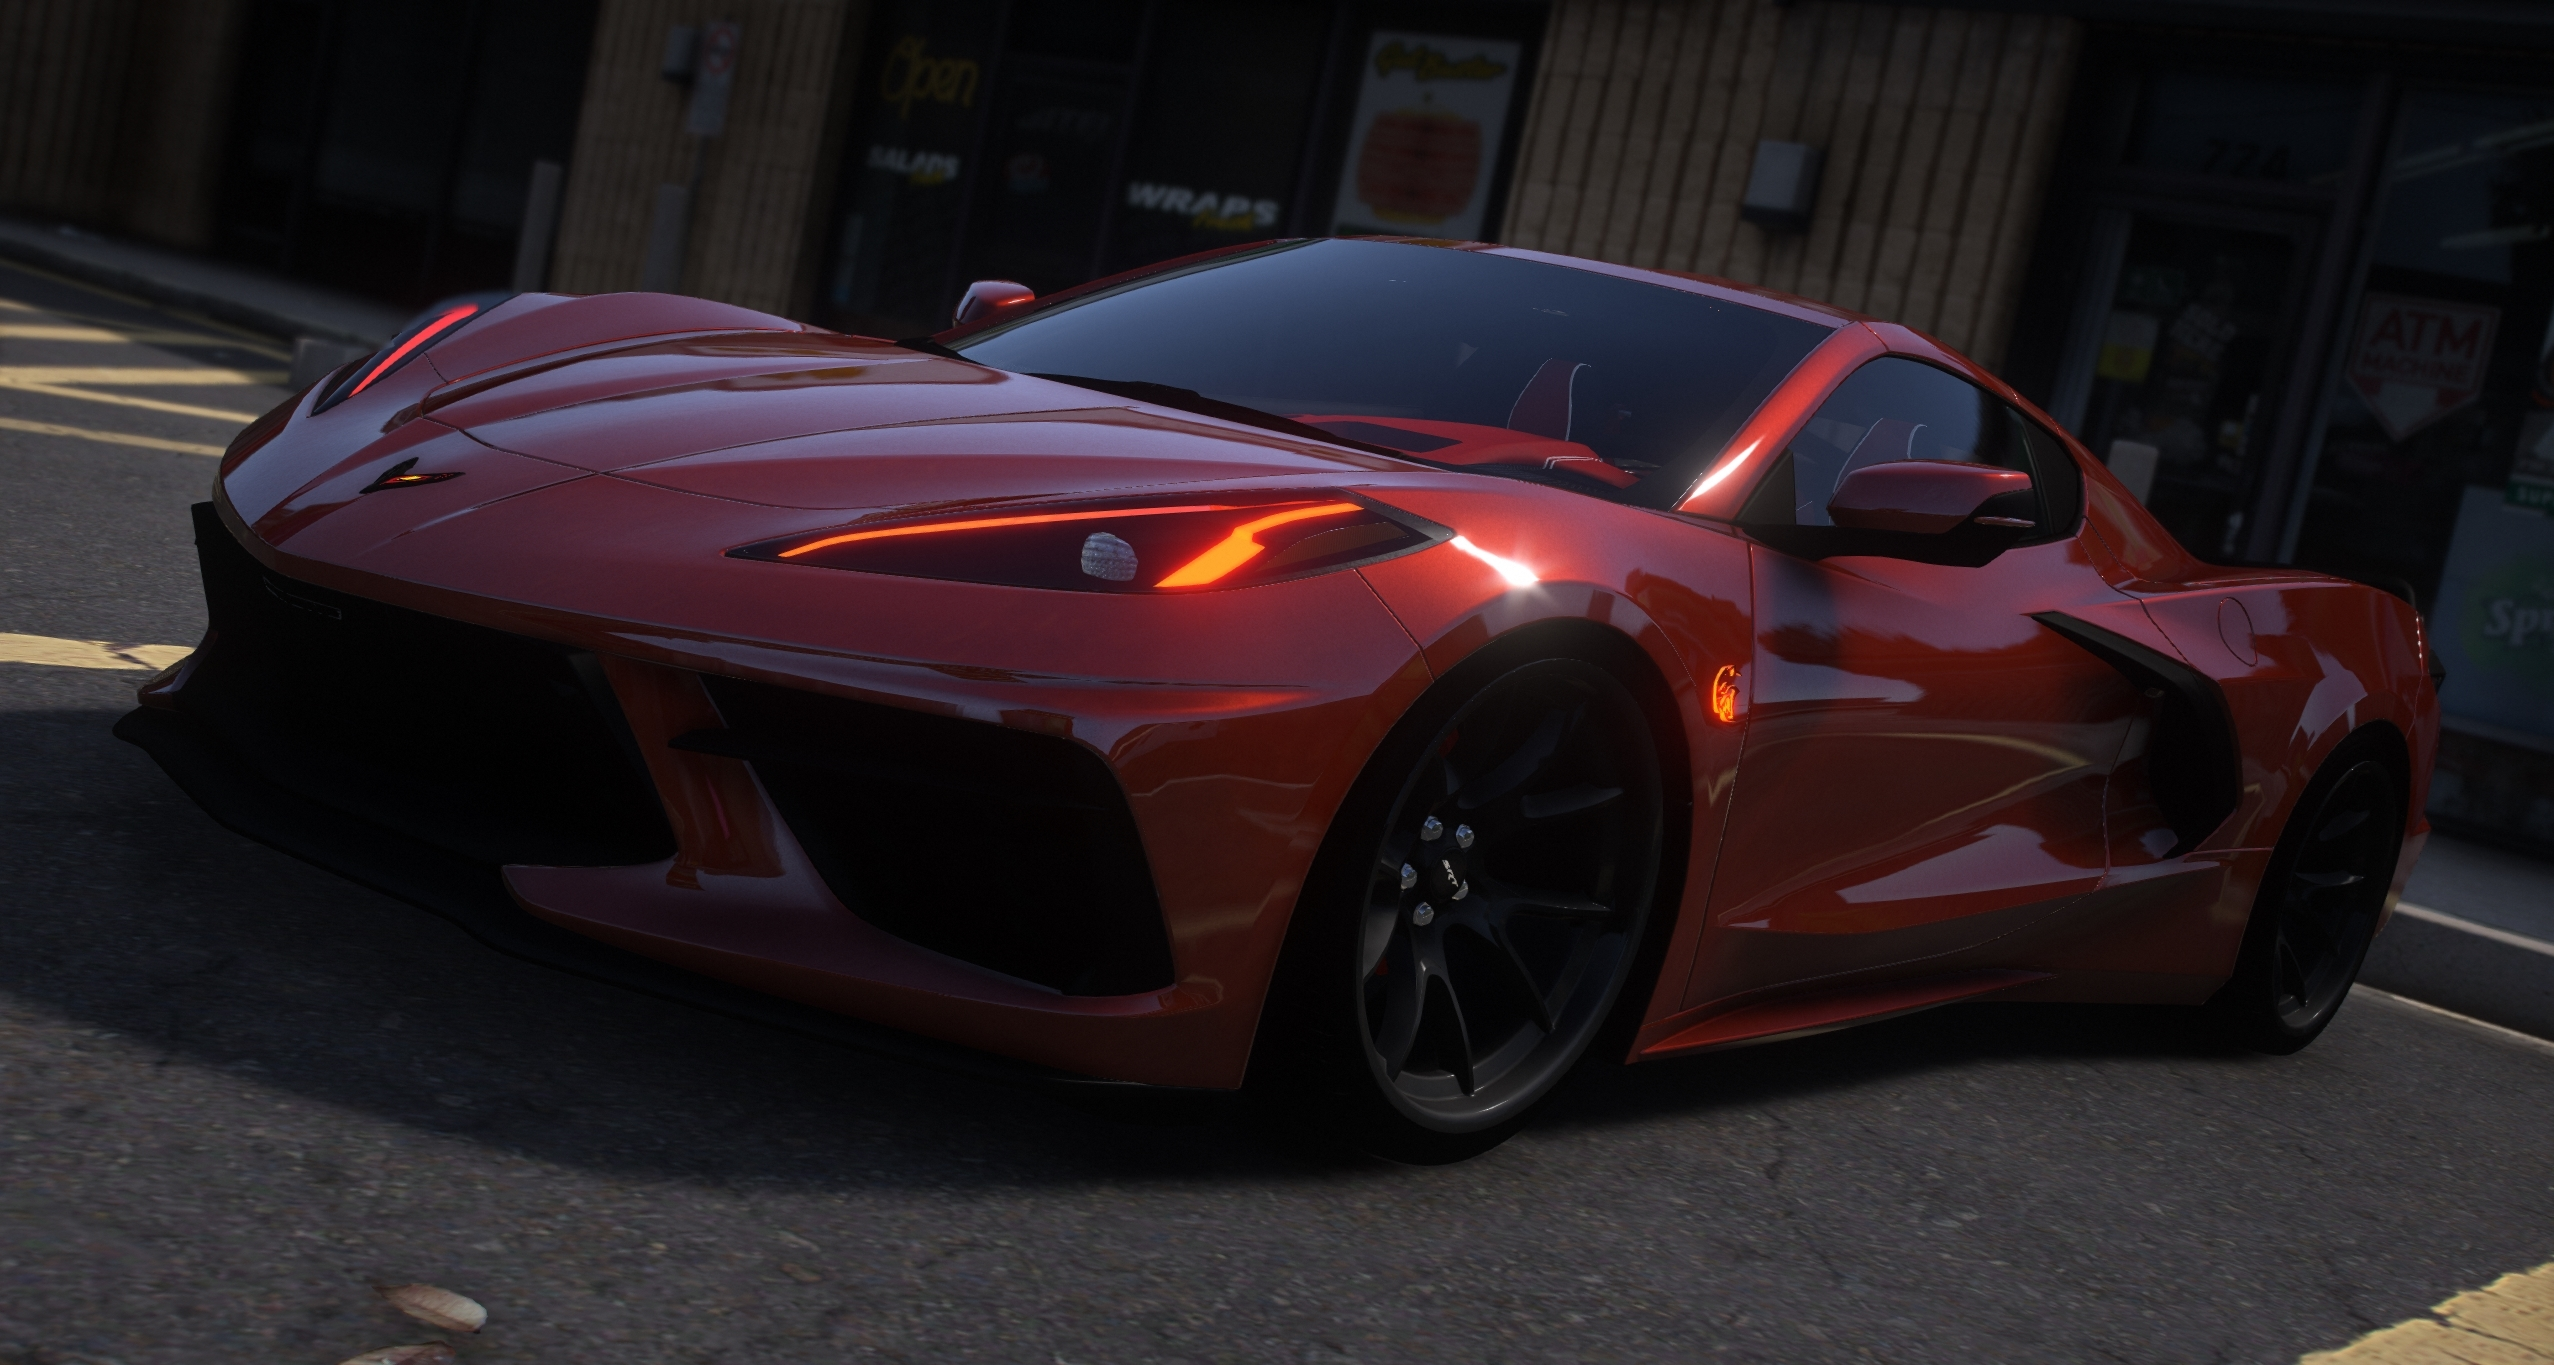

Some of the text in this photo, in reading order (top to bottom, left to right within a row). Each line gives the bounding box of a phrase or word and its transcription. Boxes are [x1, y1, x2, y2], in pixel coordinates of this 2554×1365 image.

[880, 34, 981, 121] Open
[1126, 180, 1279, 227] WRAPS
[2369, 309, 2483, 359] ATM
[2362, 353, 2470, 383] MACHINE
